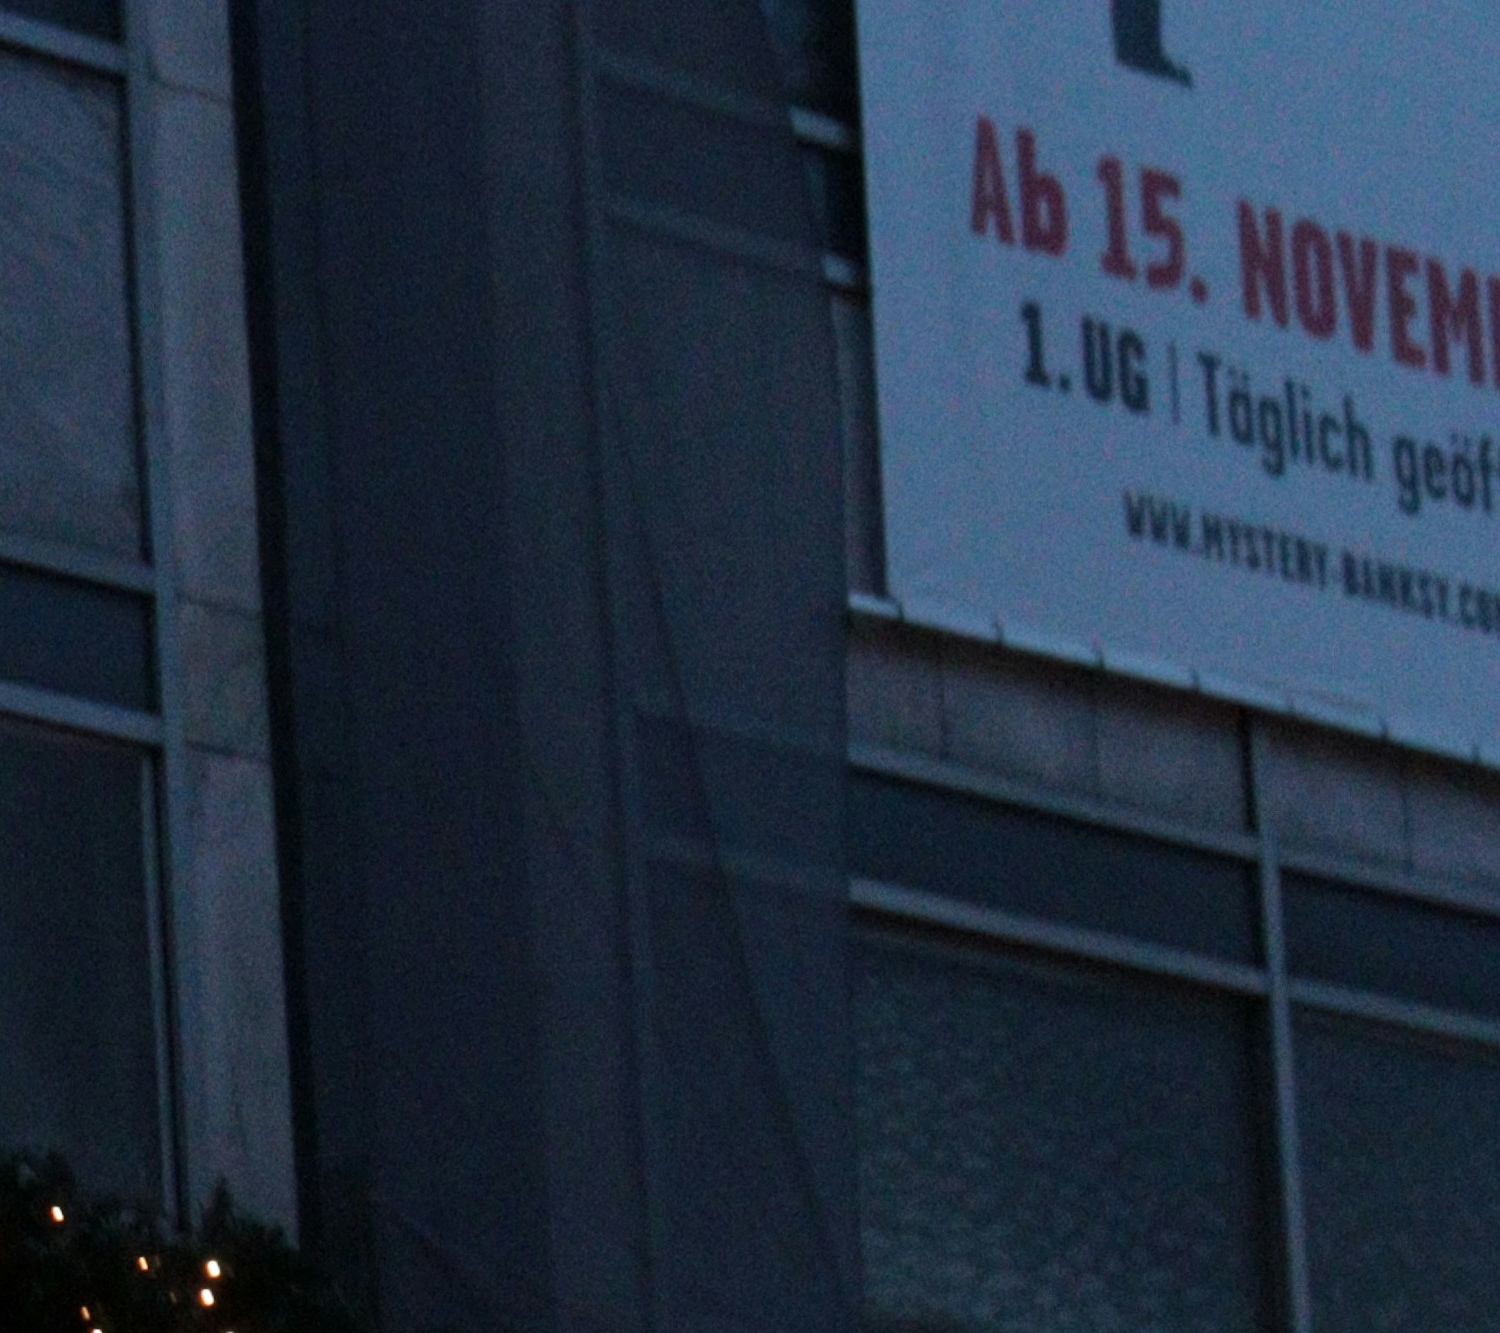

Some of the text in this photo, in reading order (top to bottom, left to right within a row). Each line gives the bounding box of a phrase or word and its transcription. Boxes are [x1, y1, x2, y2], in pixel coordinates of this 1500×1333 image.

[971, 112, 1500, 392] Ab 15. NOVEM
[1196, 350, 1376, 479] Täglich
[1123, 488, 1500, 640] WWW.MYSTERY-BANKSY.CO
